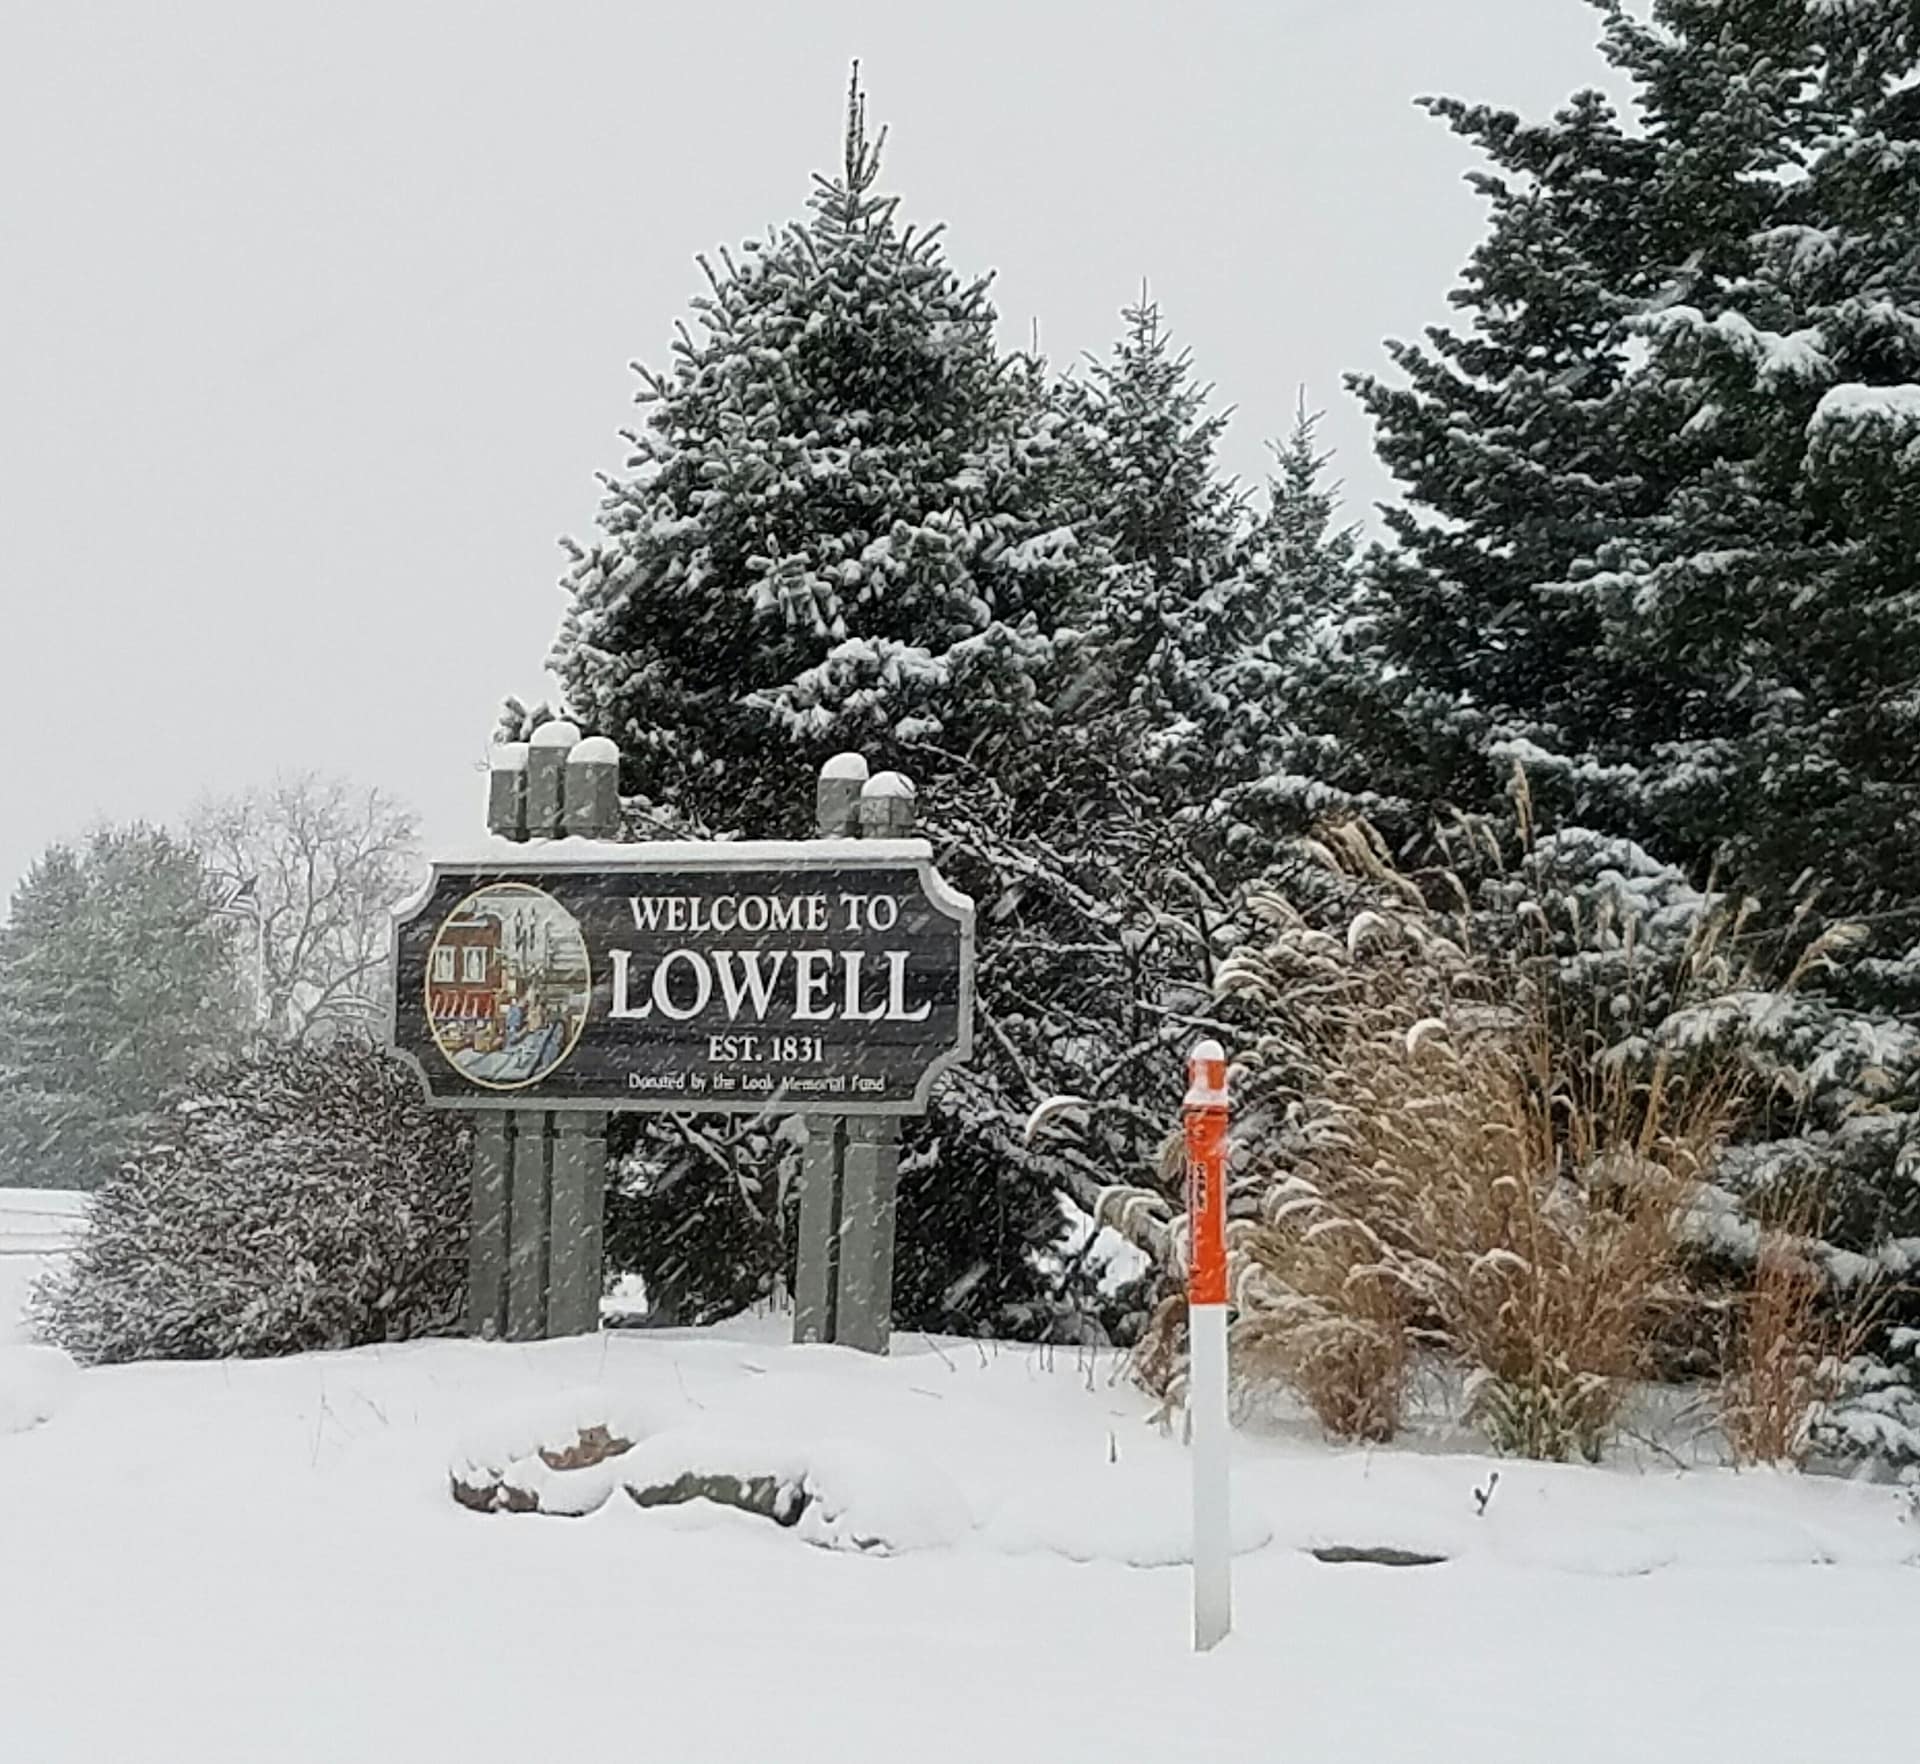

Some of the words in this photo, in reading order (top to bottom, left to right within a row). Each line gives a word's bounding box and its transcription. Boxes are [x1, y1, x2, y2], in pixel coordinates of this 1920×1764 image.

[629, 896, 829, 931] WELCOME
[840, 895, 899, 931] TO
[608, 949, 933, 1021] LOWELL
[709, 1037, 763, 1062] EST.
[772, 1037, 823, 1063] 1831
[629, 1073, 685, 1090] Donated
[691, 1073, 707, 1092] by
[713, 1072, 736, 1090] the
